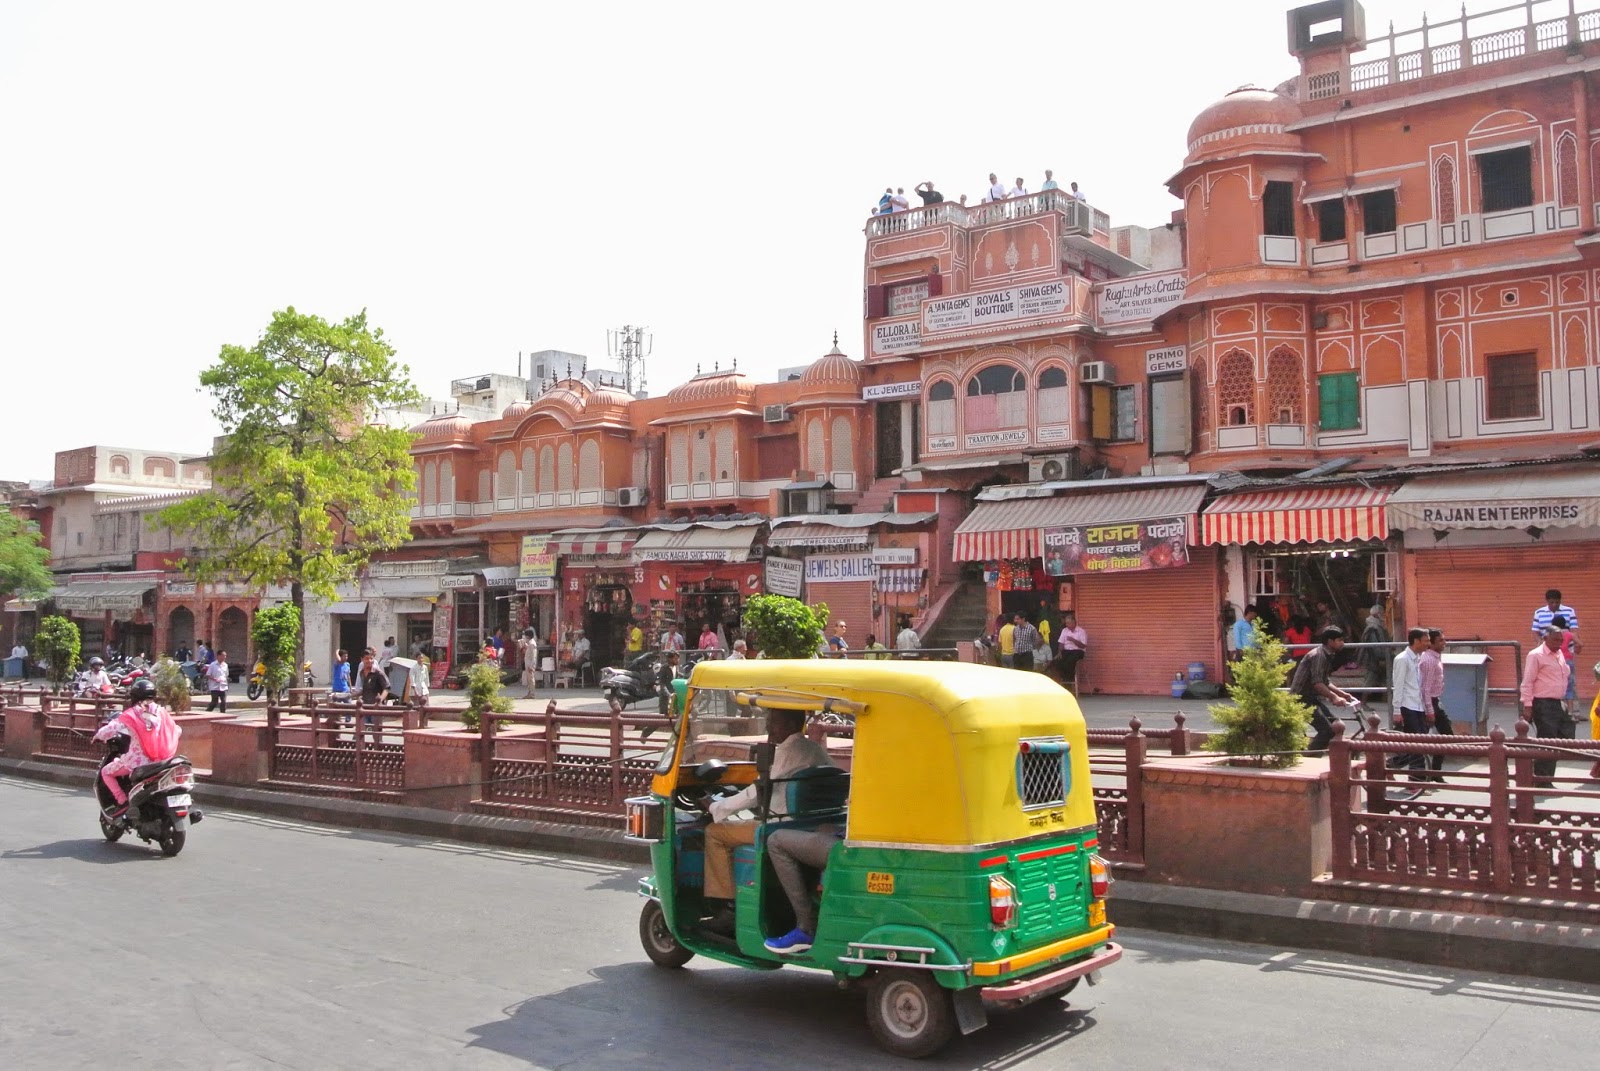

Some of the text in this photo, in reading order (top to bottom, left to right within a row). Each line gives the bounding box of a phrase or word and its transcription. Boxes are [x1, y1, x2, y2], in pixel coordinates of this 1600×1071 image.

[915, 284, 928, 293] ART
[1019, 288, 1040, 300] SHIVA
[1041, 283, 1062, 296] GEMS
[1157, 278, 1186, 293] Crafts
[954, 297, 970, 309] GEMS
[976, 290, 1011, 306] ROYAL'S
[1132, 298, 1152, 307] SILVER
[1152, 294, 1180, 304] JEWELLERY
[974, 302, 1014, 317] BOUTIQUE
[877, 324, 909, 338] ELLORA
[1148, 349, 1184, 361] PRIMO
[1150, 360, 1183, 372] GEMS
[968, 431, 1025, 444] TRADITION JEWELS
[1423, 505, 1579, 522] RAJAN ENTERPRISES
[1086, 524, 1139, 544] राजन
[1147, 518, 1185, 538] पटाखे
[1045, 528, 1080, 546] पटाखे
[839, 541, 874, 553] GALLERY
[1086, 545, 1115, 555] फायर
[645, 550, 726, 560] FAMOUS NAGRA SHOE STORE
[806, 558, 839, 578] JEWELS
[441, 578, 472, 587] CRAFTS CORNER
[488, 578, 507, 586] CRAFTS
[634, 571, 644, 583] 33
[534, 579, 548, 588] HOUSE
[569, 581, 579, 591] 33
